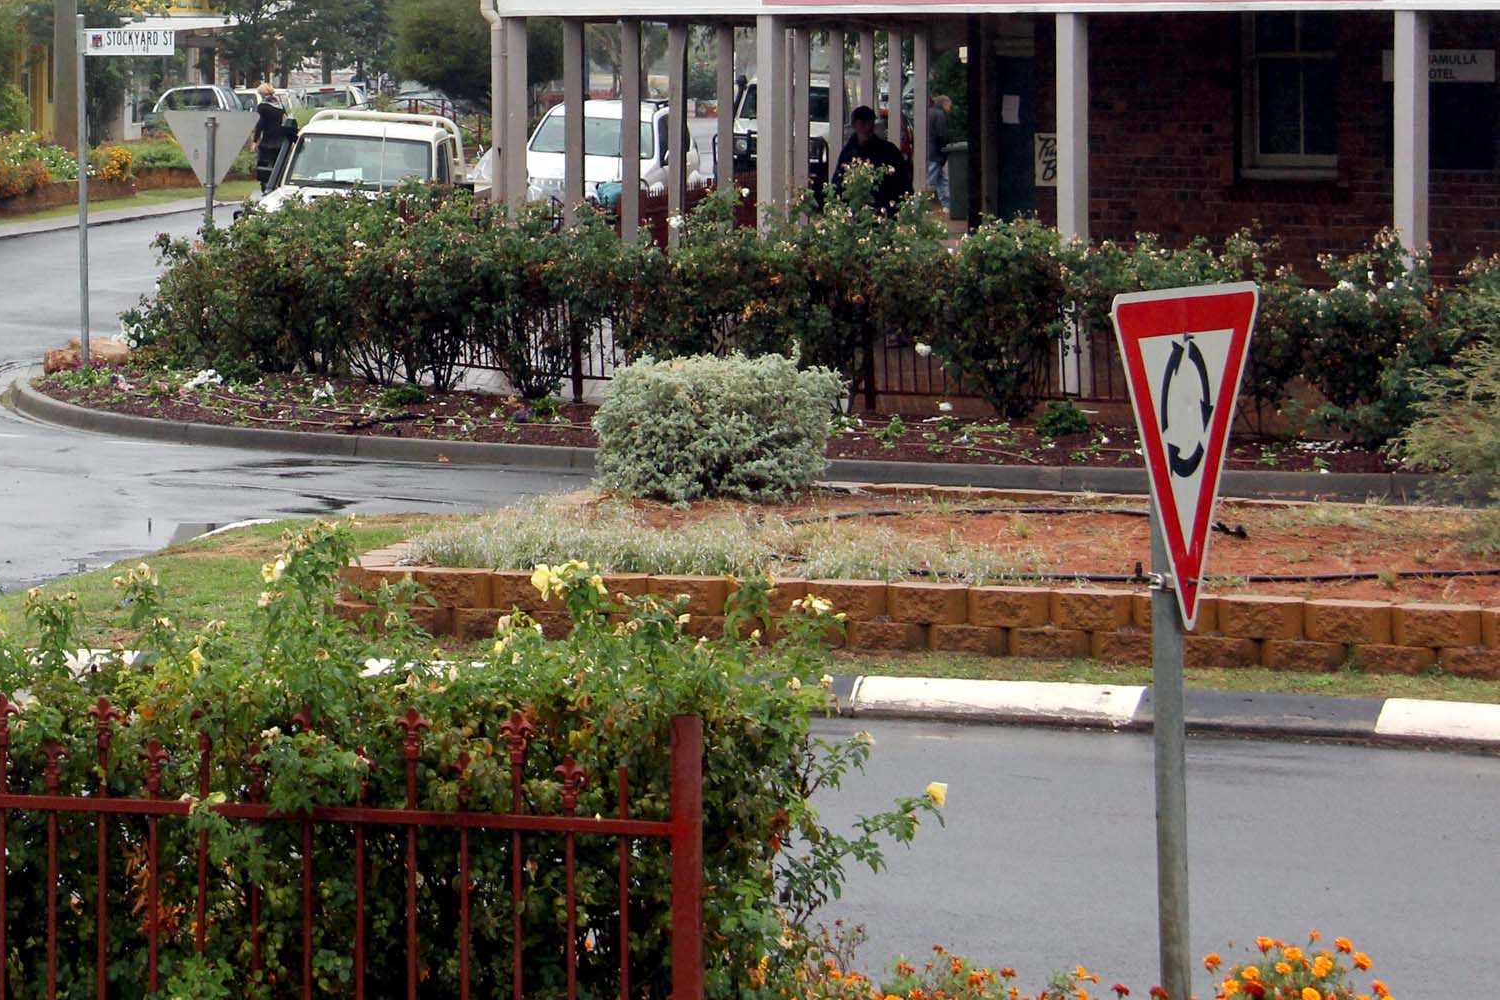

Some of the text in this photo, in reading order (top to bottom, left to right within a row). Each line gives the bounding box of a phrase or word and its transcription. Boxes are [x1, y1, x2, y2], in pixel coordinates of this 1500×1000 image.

[106, 31, 173, 46] STOCKYARD ST
[1428, 68, 1455, 79] OTEL
